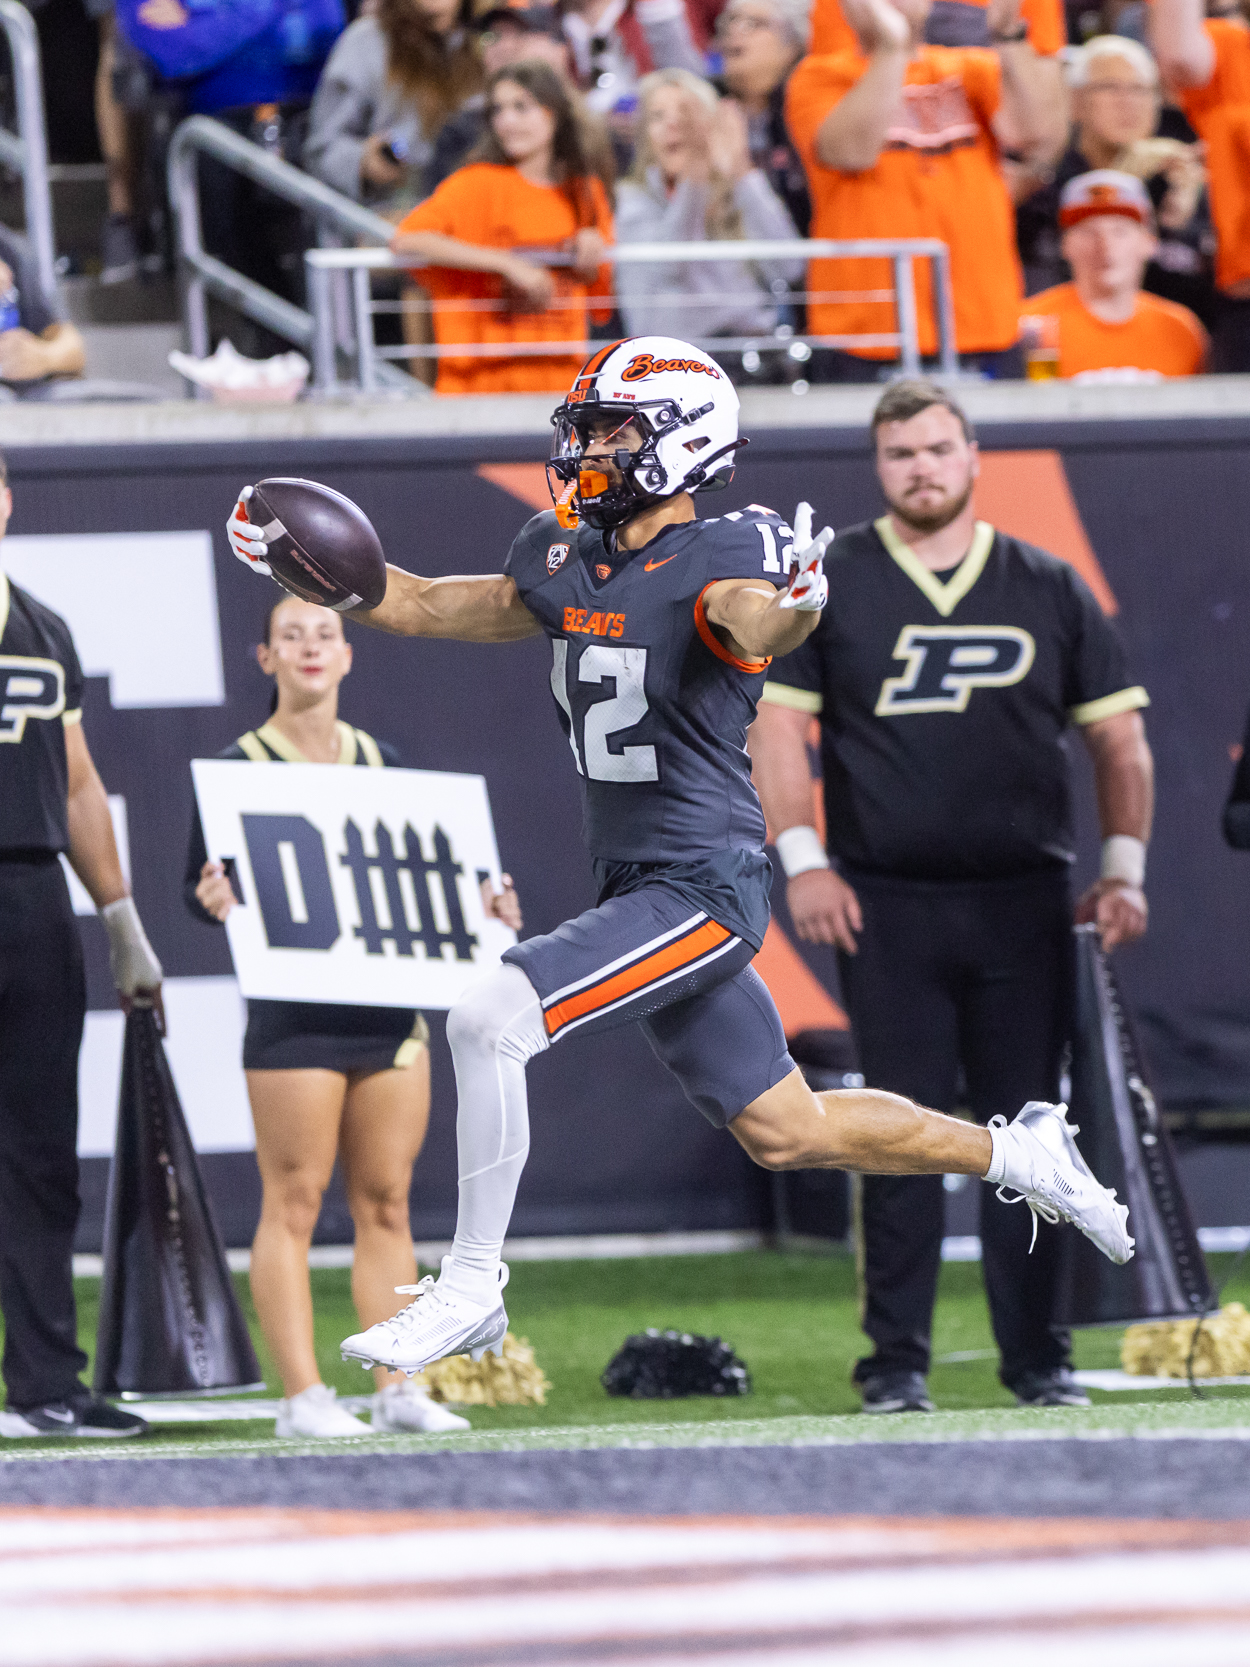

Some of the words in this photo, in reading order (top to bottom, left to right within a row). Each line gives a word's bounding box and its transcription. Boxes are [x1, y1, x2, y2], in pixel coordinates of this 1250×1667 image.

[621, 353, 720, 382] Beavers
[562, 606, 626, 638] BEAVS
[550, 638, 660, 782] 12
[873, 624, 1036, 717] P
[240, 813, 342, 953] D
